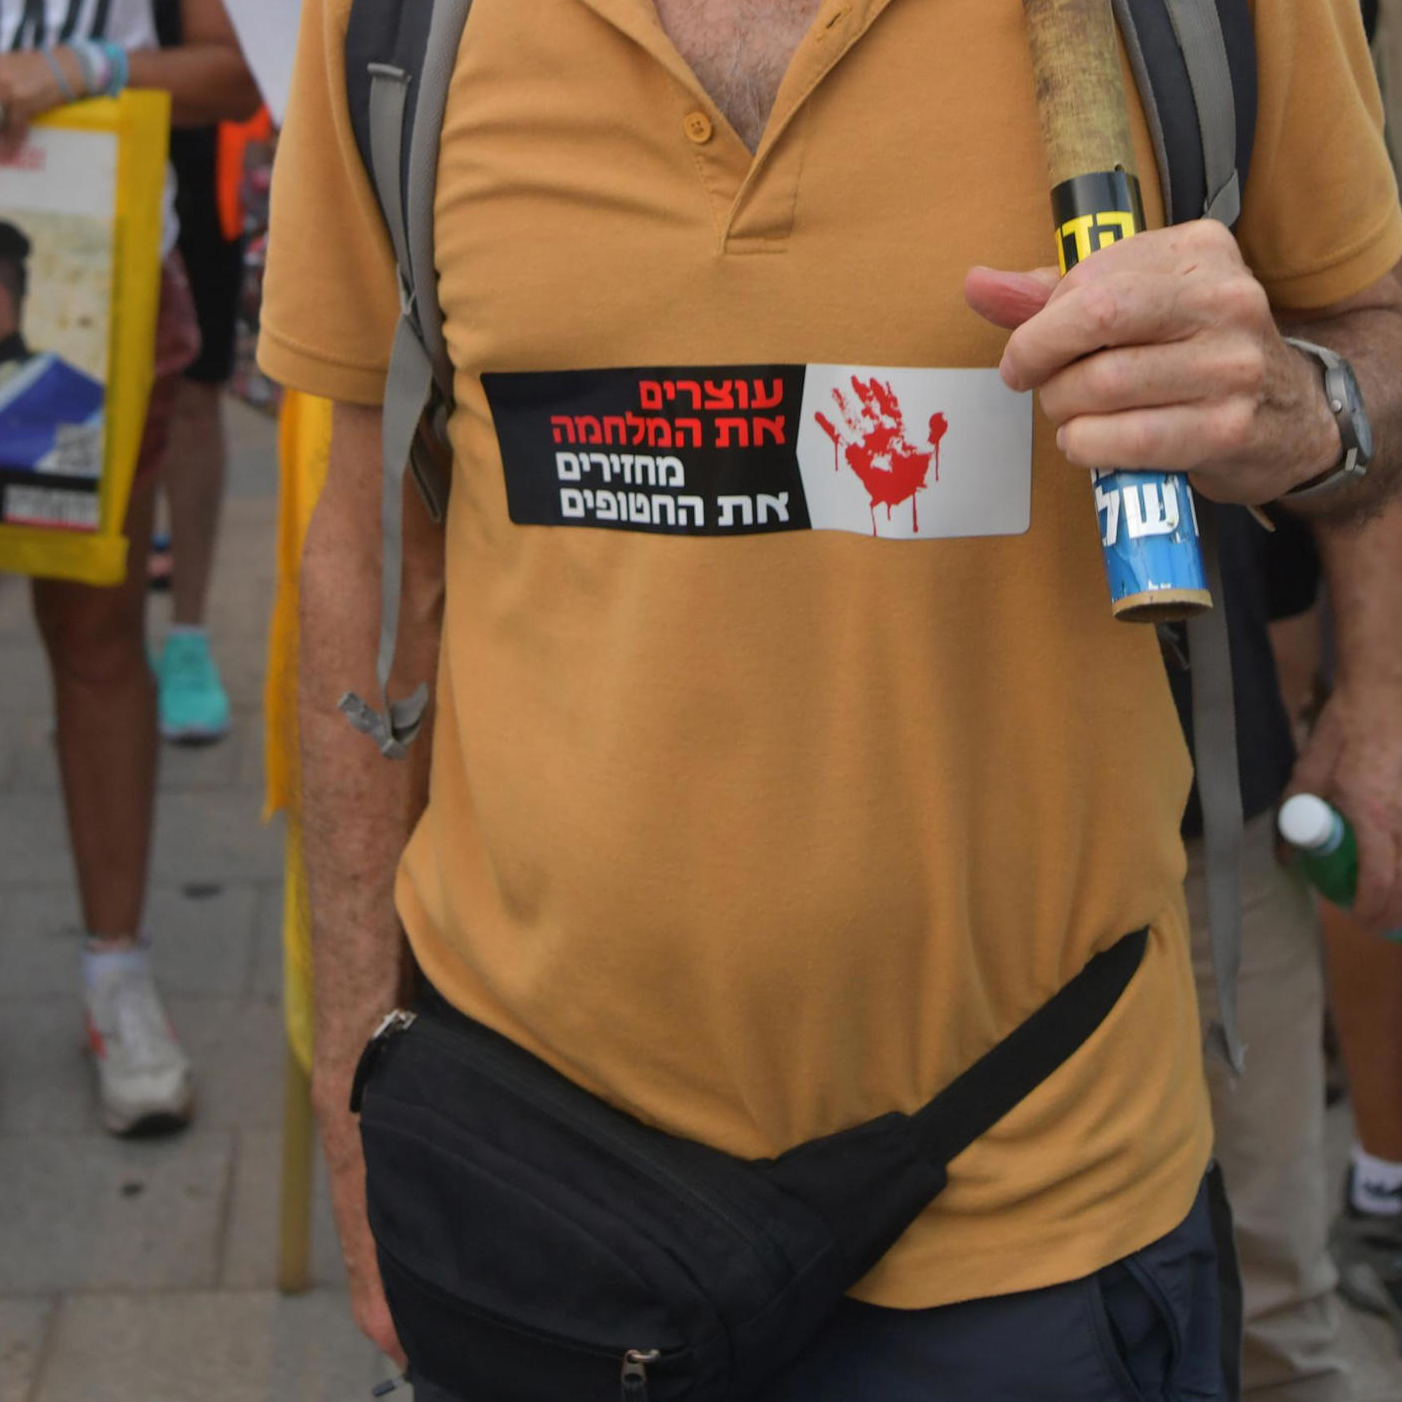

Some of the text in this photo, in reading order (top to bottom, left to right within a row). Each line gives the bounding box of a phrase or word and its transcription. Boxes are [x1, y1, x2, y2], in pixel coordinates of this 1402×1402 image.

[639, 378, 784, 411] עוצרים
[550, 411, 786, 449] את המלחמה
[555, 452, 686, 488] מחזירים
[559, 488, 790, 527] את החטופים
